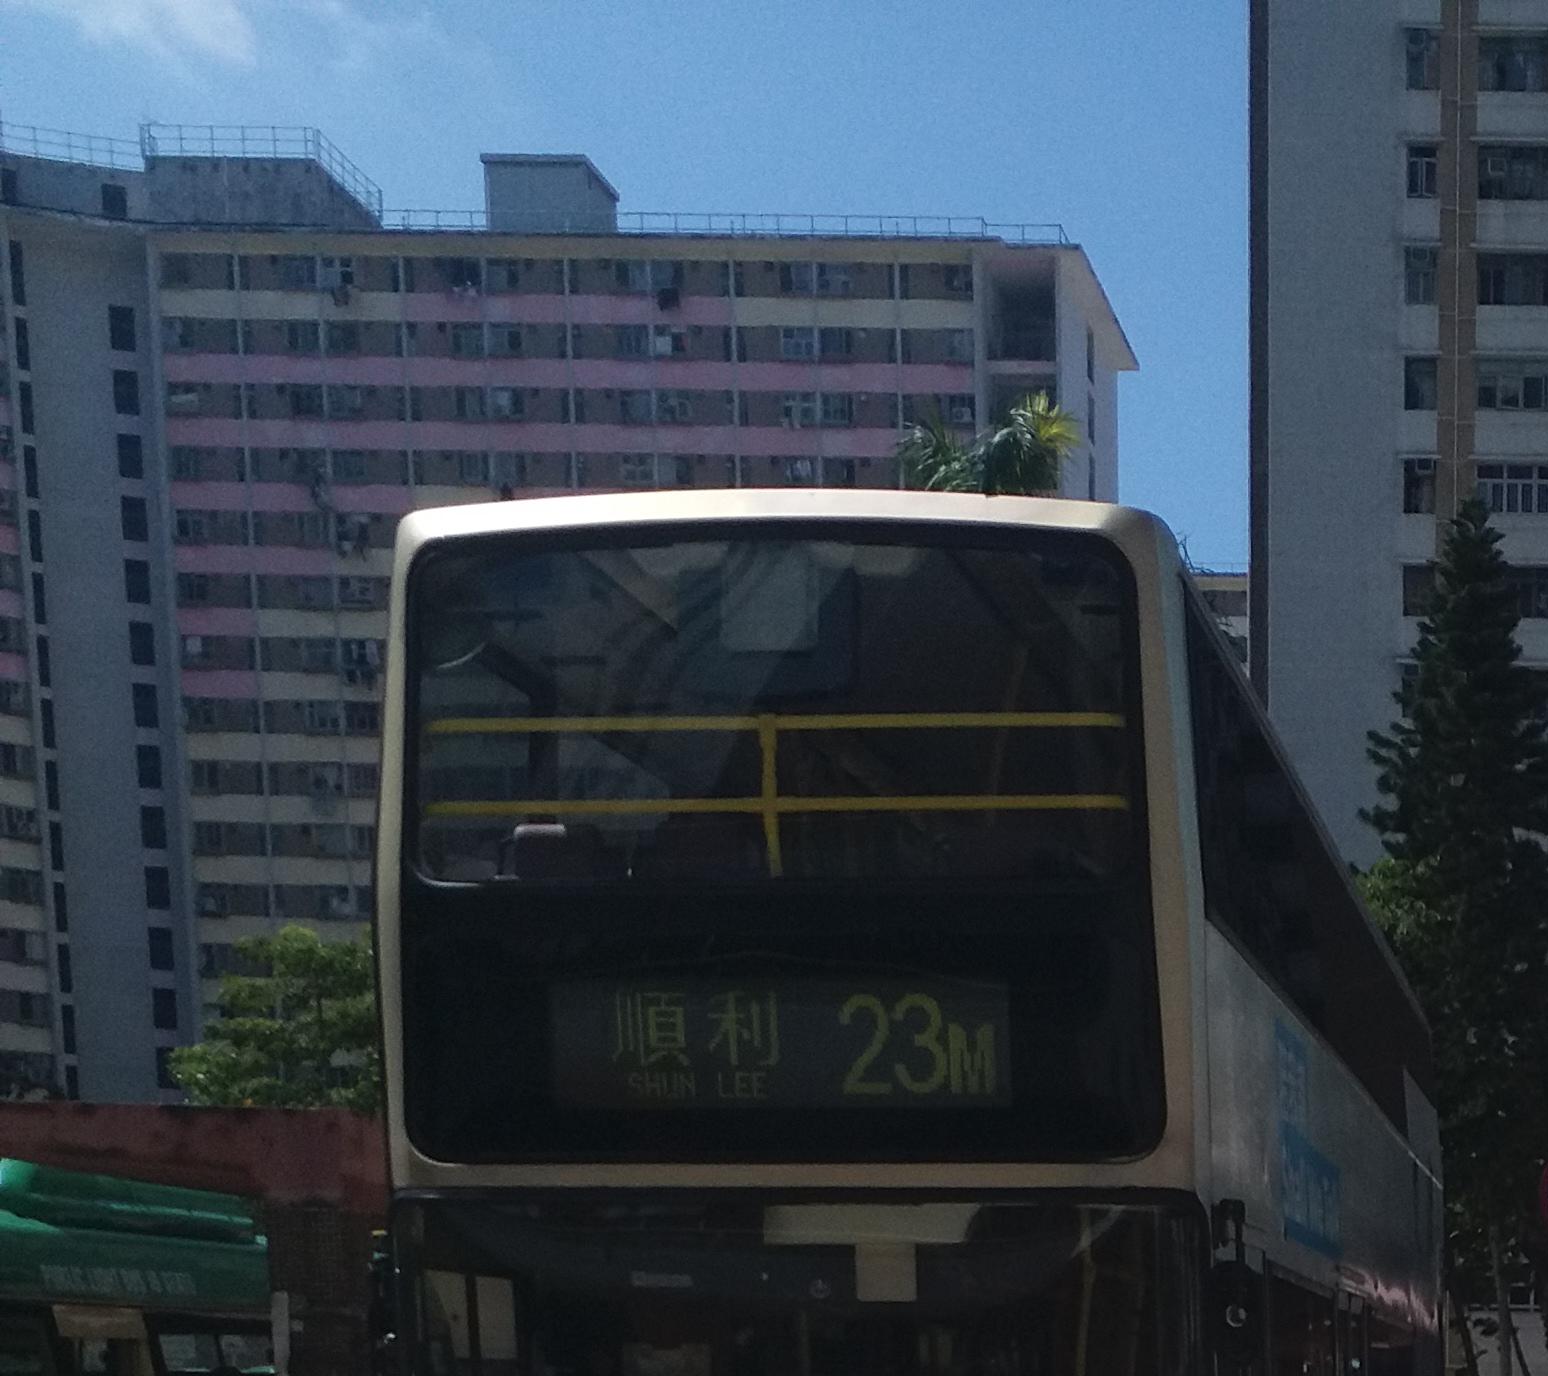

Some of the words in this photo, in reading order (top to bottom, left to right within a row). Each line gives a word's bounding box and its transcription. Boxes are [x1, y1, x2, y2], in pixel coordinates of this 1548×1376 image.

[611, 989, 783, 1068] 順利
[837, 992, 996, 1096] 23M
[626, 1070, 697, 1099] SHUN
[717, 1070, 771, 1100] LEE
